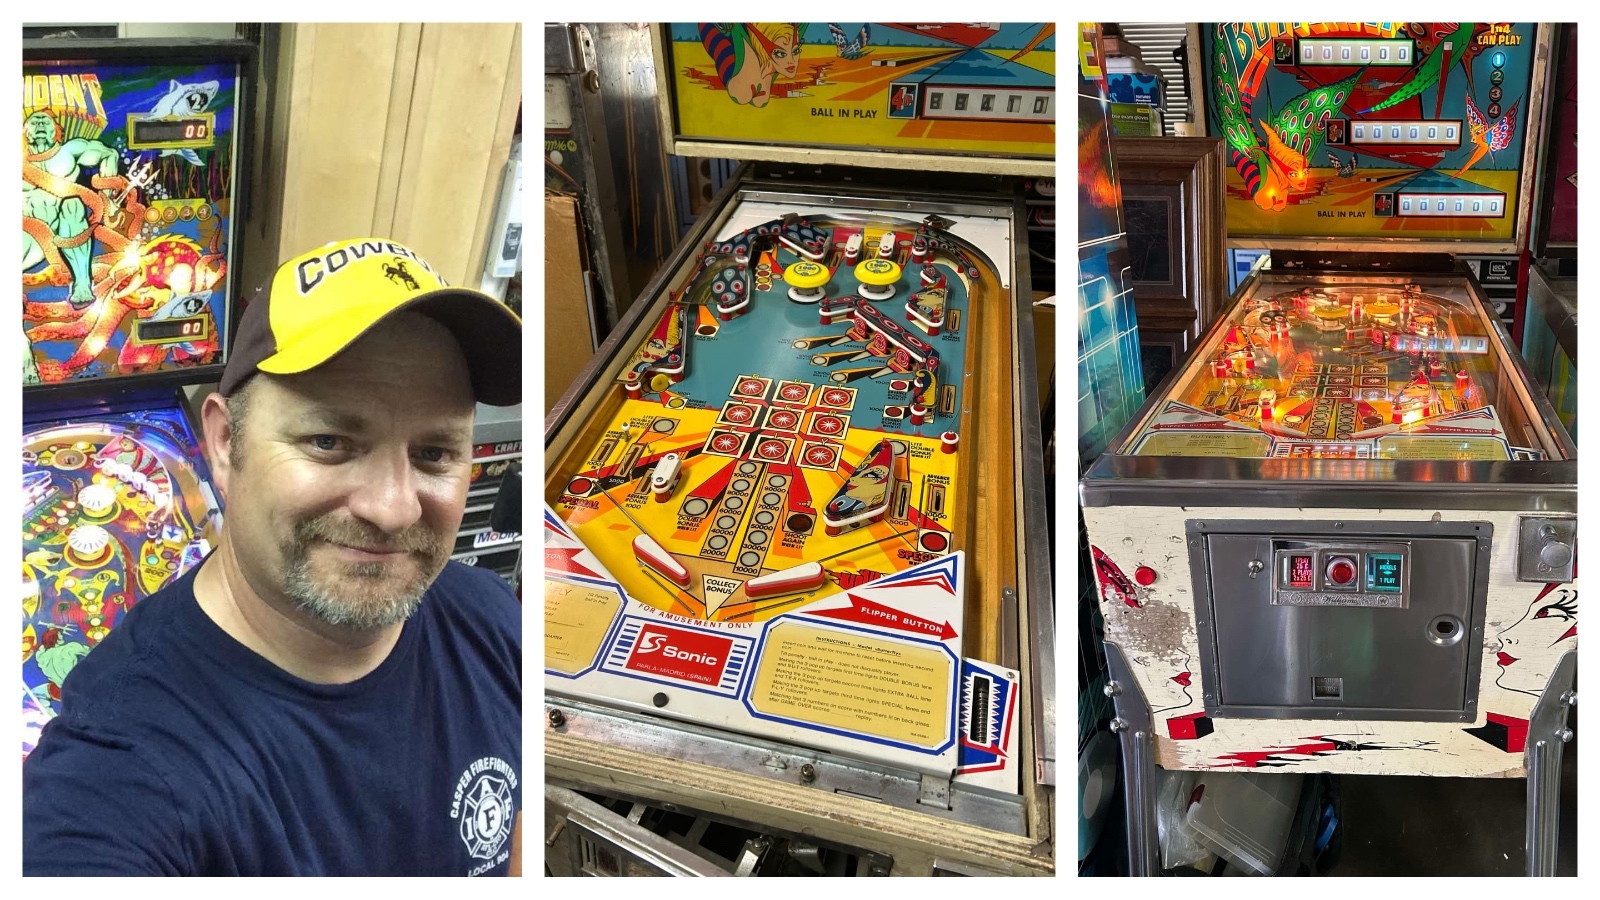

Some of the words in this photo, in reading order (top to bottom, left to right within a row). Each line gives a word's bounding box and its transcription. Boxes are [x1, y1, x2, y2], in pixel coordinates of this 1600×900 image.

[1477, 35, 1495, 45] CAN
[1498, 35, 1522, 45] PLAY
[1496, 55, 1501, 64] 1
[1493, 71, 1501, 81] 2
[1492, 90, 1500, 98] 3
[811, 108, 835, 117] BALL
[838, 108, 851, 118] IN
[853, 110, 878, 119] PLAY
[1490, 106, 1498, 114] 4
[558, 495, 599, 509] SPECIAL
[711, 528, 734, 536] 40000
[784, 532, 808, 540] SHOOT
[742, 544, 766, 552] 30000
[702, 549, 725, 557] 20000
[735, 566, 758, 574] 10000
[706, 579, 738, 588] COLLECT
[706, 586, 732, 594] BONUS
[639, 603, 656, 614] FOR
[658, 611, 722, 628] AMUSEMENT
[861, 606, 898, 622] FLIPPER
[903, 617, 943, 633] BUTTON
[816, 637, 850, 645] INSTRUCTIONS
[662, 645, 718, 666] Sonic
[686, 672, 712, 682] (SPAIN)
[880, 676, 899, 684] DOUBLE
[882, 701, 903, 709] SPECIAL
[450, 770, 472, 818] CASPER
[470, 757, 518, 789] FIREFIGHTERS
[483, 805, 496, 832] F
[468, 859, 496, 877] LOCAL
